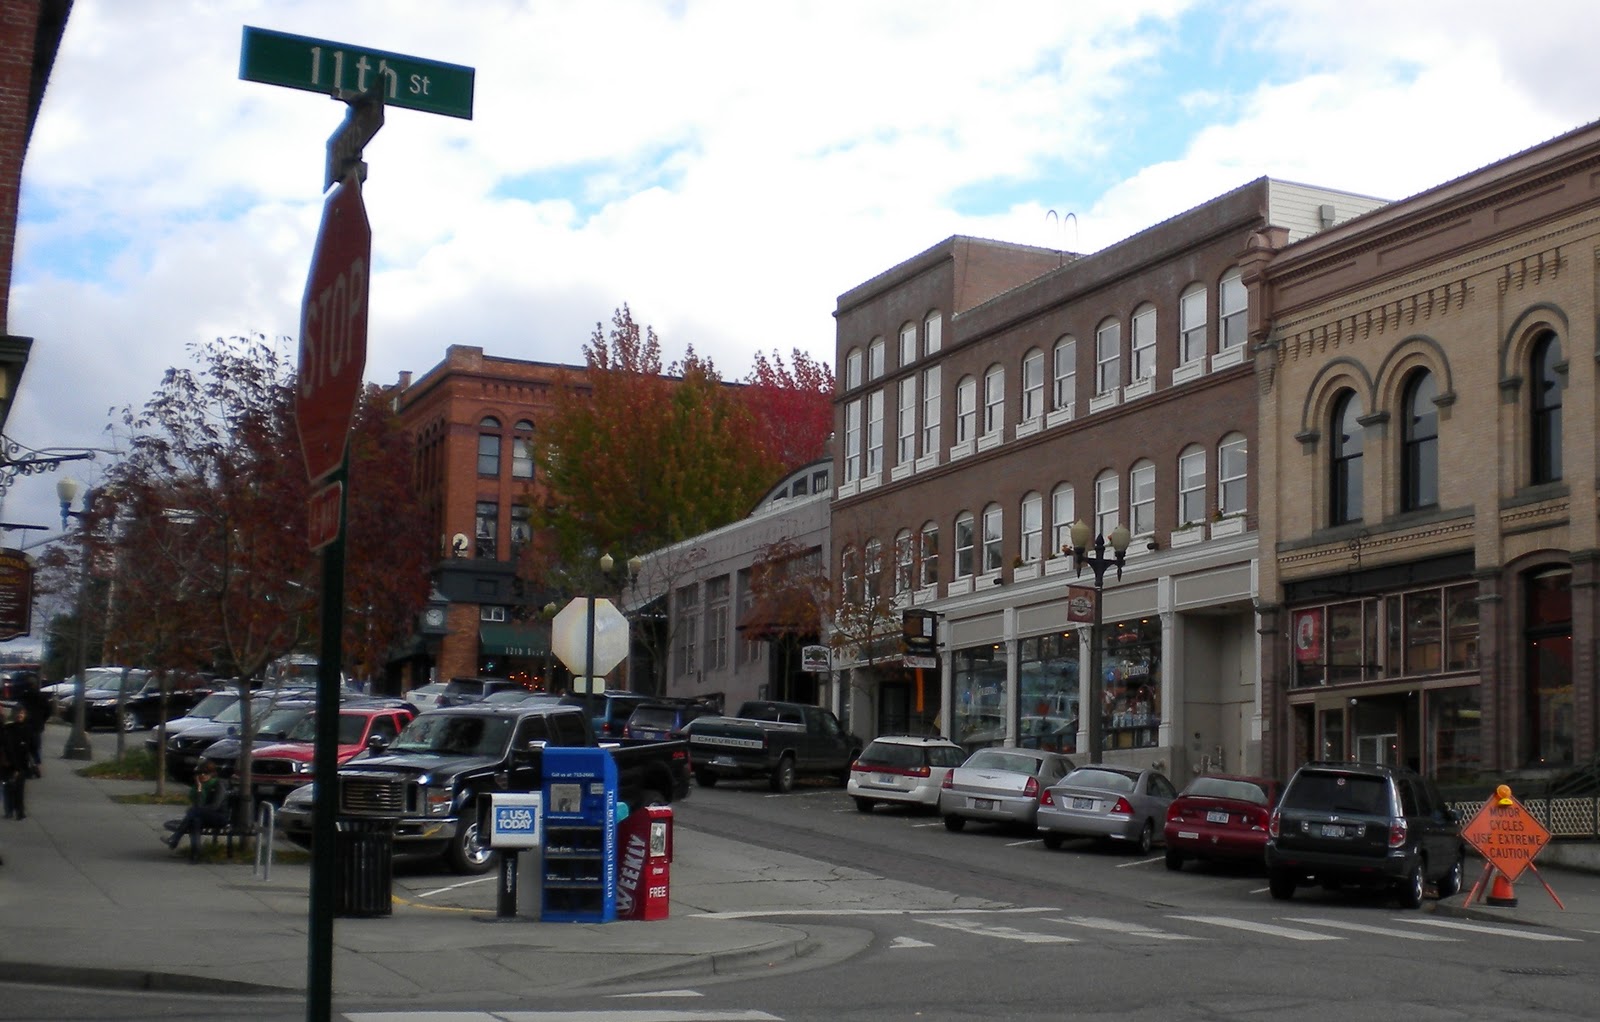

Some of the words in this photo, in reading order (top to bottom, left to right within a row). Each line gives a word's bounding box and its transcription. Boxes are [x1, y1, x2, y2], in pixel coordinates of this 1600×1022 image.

[310, 46, 398, 99] 11th
[408, 73, 432, 96] St
[302, 256, 364, 400] STOP
[697, 736, 755, 747] CHEVROLET
[510, 810, 532, 819] USA
[1490, 807, 1520, 817] MOTOR
[498, 819, 533, 829] TODAY
[1490, 820, 1524, 831] CYCLES
[1473, 833, 1493, 844] USE
[1499, 834, 1542, 845] EXTREME
[1490, 847, 1530, 859] CAUTION
[616, 834, 646, 910] WEEKLY
[649, 886, 666, 899] FREE
